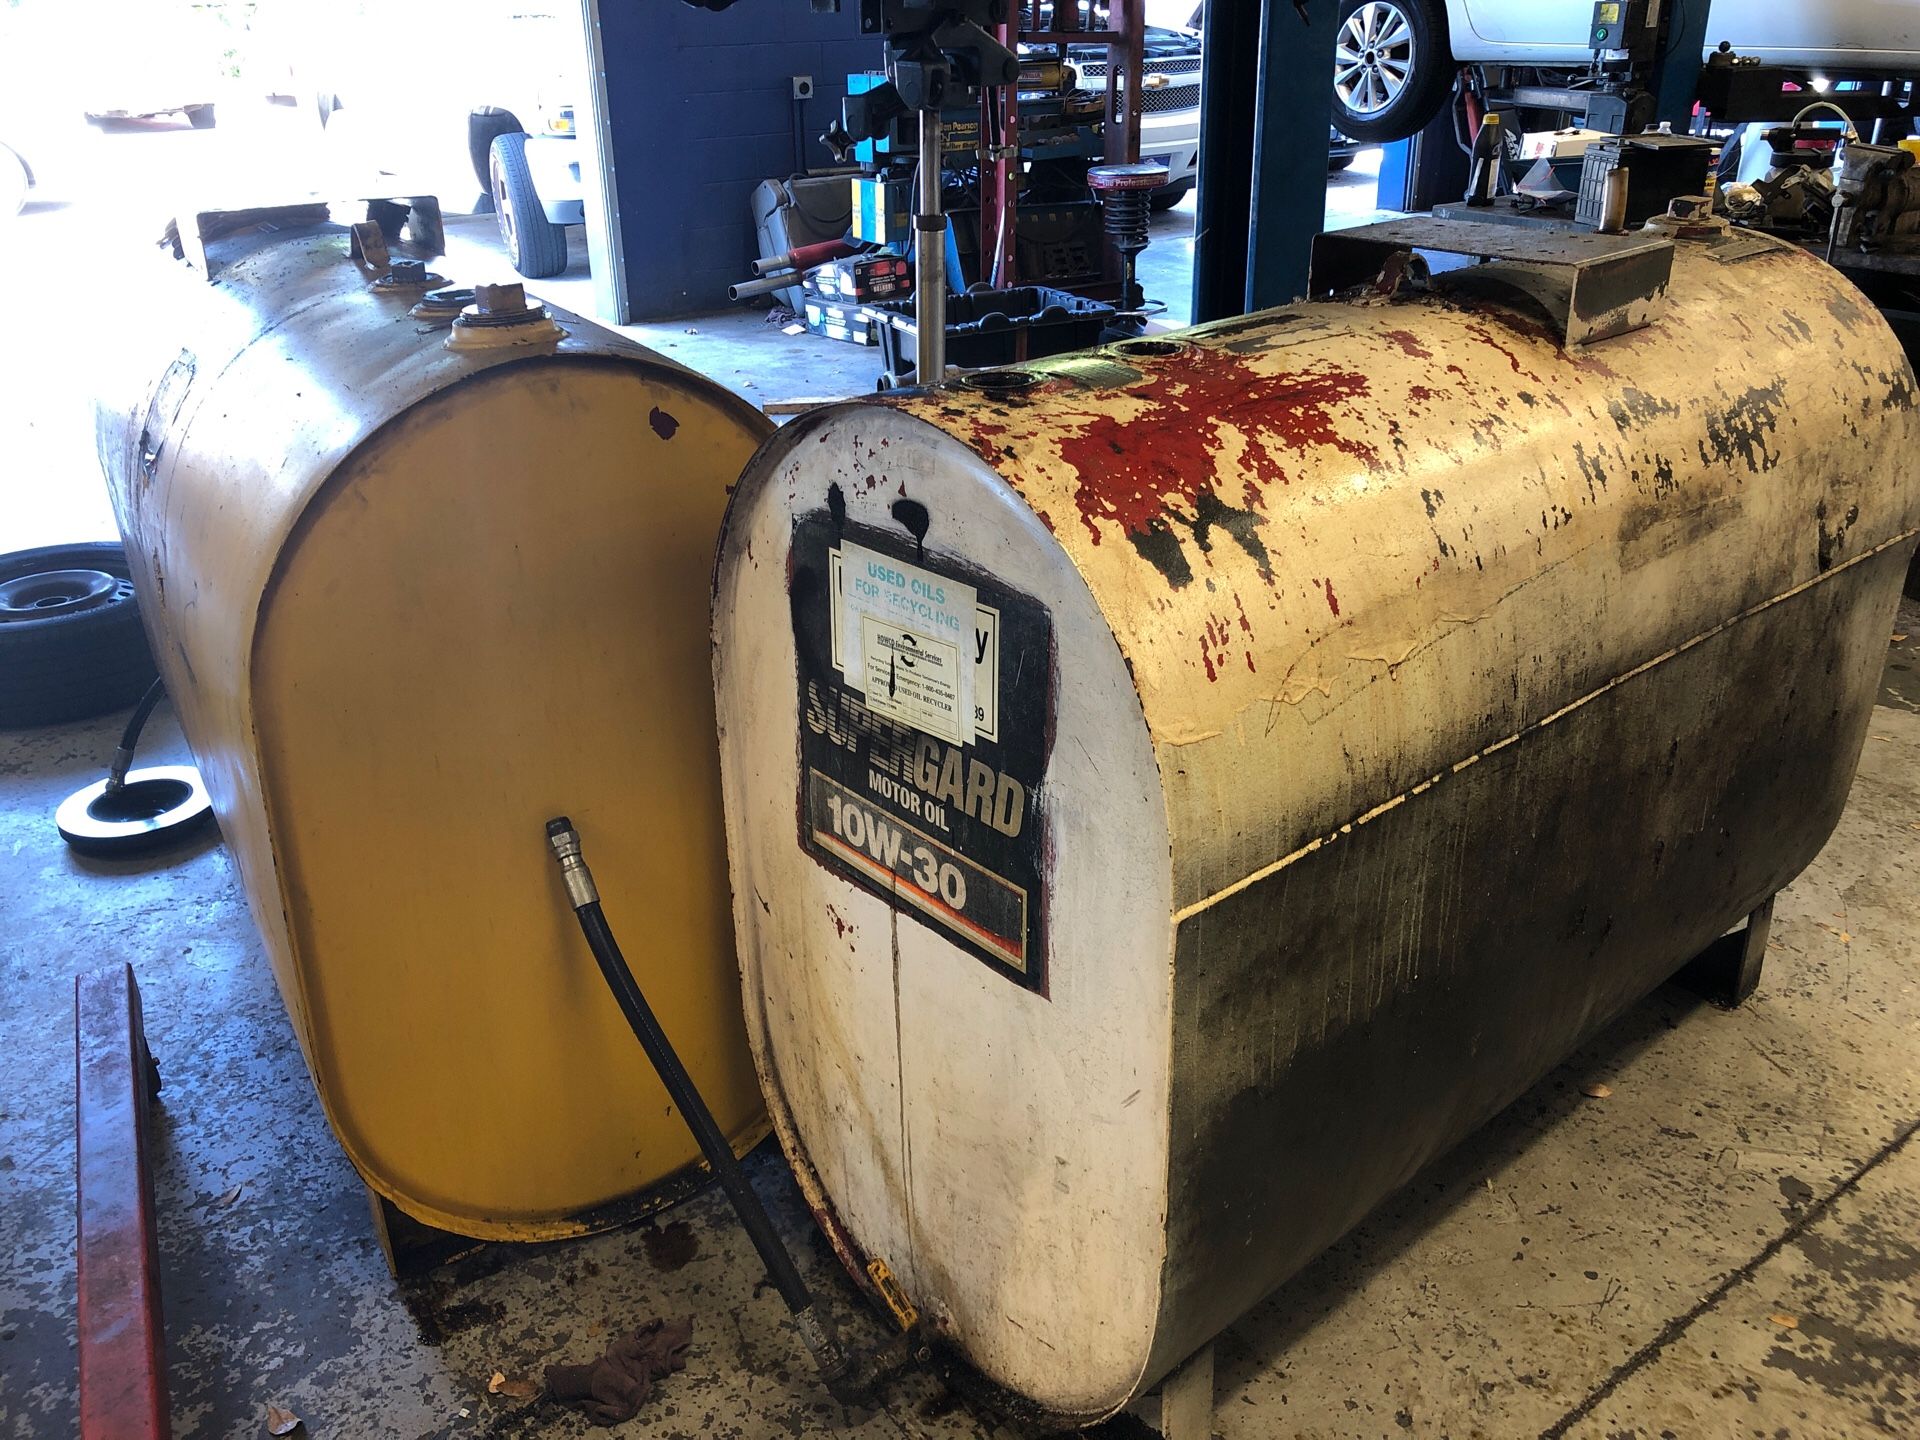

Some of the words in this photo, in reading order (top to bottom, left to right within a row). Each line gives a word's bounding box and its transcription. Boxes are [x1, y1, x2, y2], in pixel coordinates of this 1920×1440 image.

[855, 577, 880, 598] FOR
[867, 561, 906, 589] USED
[911, 578, 945, 605] OILS
[895, 640, 925, 656] Environmental
[924, 650, 942, 664] Services
[872, 676, 898, 691] APPROD
[922, 695, 952, 712] RECYCLER
[806, 678, 1025, 838] SUPERGARD
[869, 769, 921, 817] MOTOR
[925, 802, 950, 832] OIL
[828, 794, 967, 910] 10W-30
